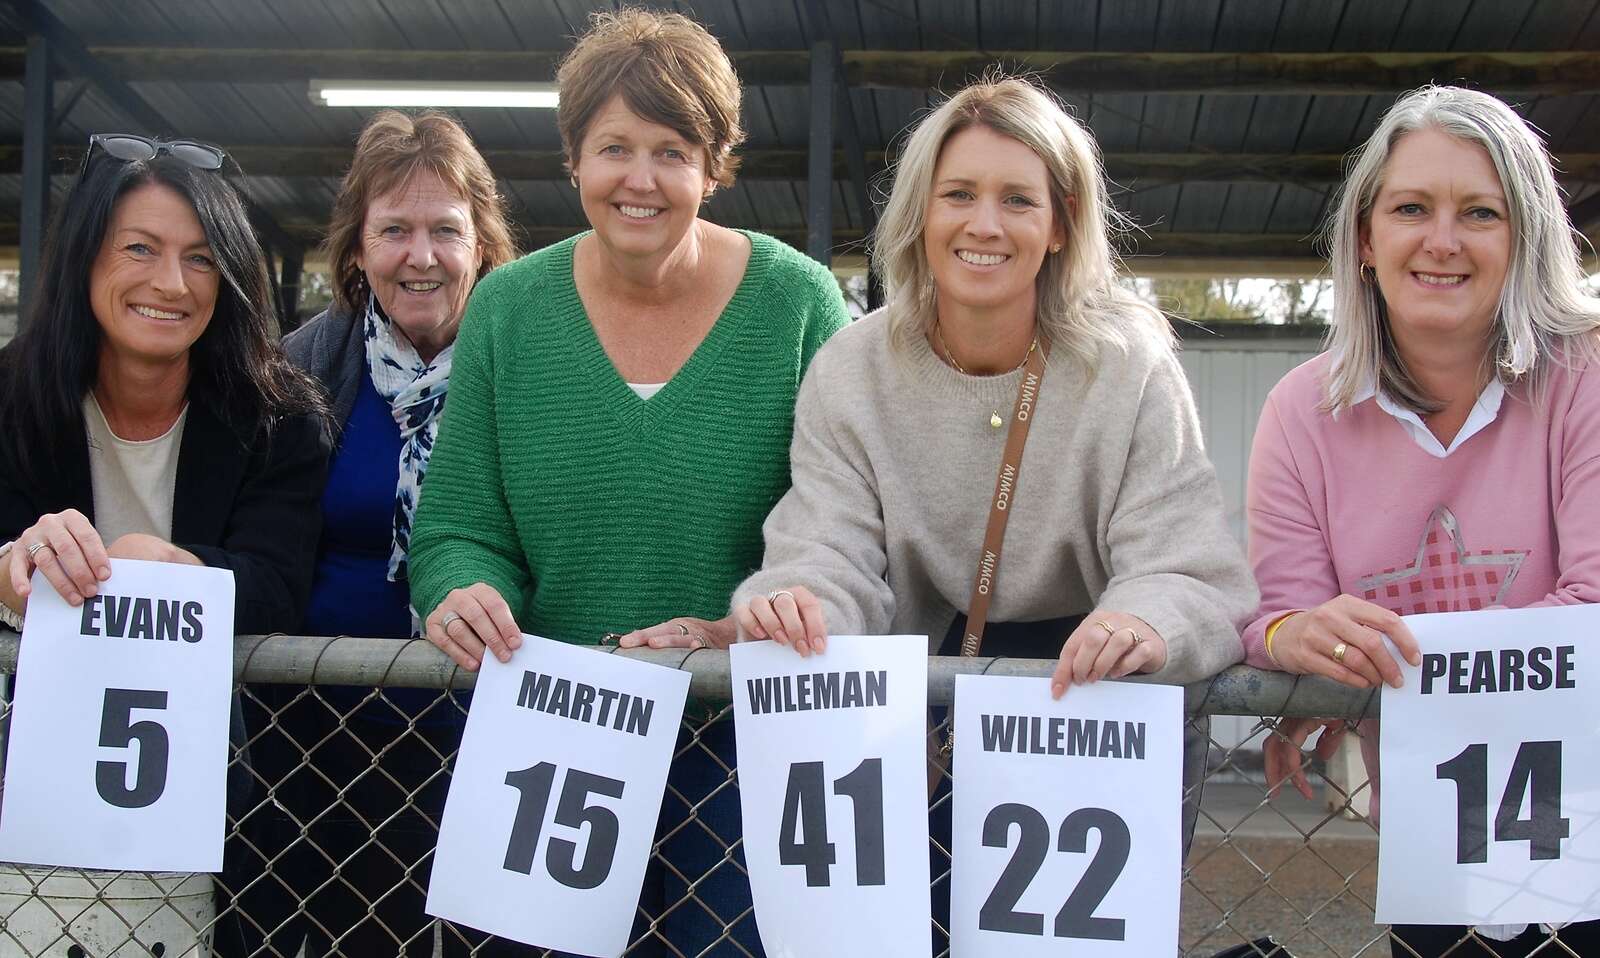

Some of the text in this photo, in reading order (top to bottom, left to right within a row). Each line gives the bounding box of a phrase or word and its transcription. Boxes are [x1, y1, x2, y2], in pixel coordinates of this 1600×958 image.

[80, 595, 203, 643] EVANS
[517, 670, 655, 737] MARTIN
[747, 670, 887, 715] WILEMAN
[1421, 645, 1576, 695] PEARSE
[95, 688, 169, 809] 5
[980, 714, 1146, 760] WILEMAN
[503, 761, 626, 890] 15
[778, 757, 886, 888] 41
[1437, 740, 1570, 865] 14
[979, 802, 1131, 942] 22
